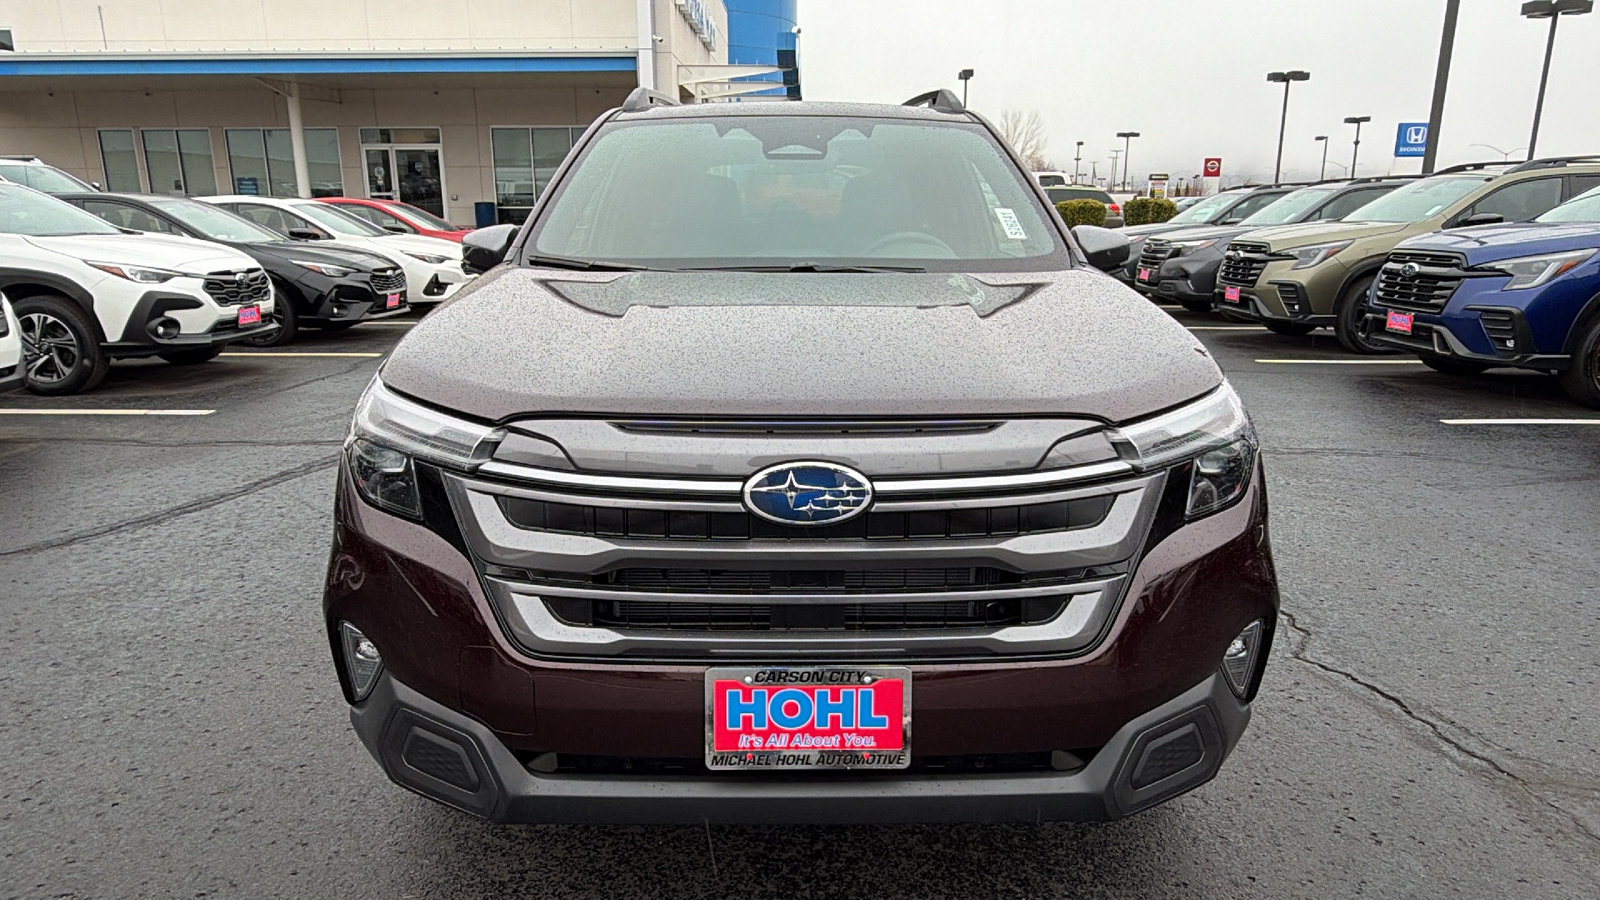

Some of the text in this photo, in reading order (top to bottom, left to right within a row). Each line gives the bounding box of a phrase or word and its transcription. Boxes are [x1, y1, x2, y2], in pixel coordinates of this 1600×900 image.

[755, 671, 866, 683] CARSON CITY
[726, 688, 889, 729] HOHL
[738, 733, 877, 748] It's All About You.
[711, 755, 906, 766] MICHAEL HOHL AUTOMOTIVE
